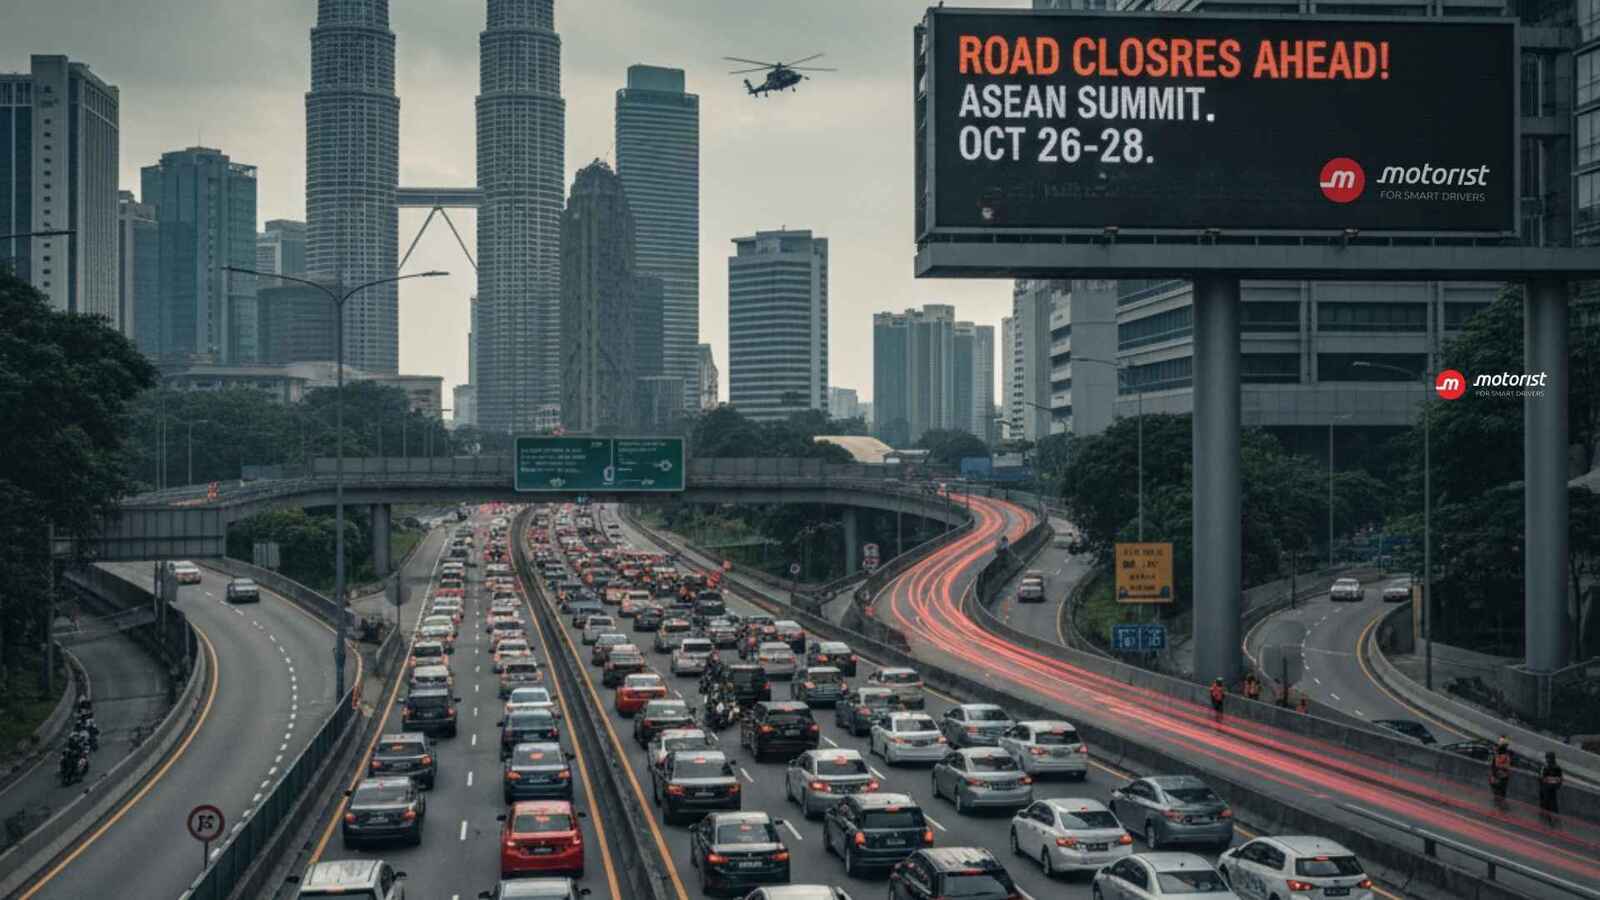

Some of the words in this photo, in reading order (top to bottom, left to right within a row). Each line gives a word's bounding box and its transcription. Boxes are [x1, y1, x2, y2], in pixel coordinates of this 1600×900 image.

[958, 34, 1060, 77] ROAD
[1072, 38, 1242, 79] CLOSRES
[1253, 40, 1390, 80] AHEAD!
[959, 83, 1067, 119] ASEAN
[1077, 85, 1216, 122] SUMMIT.
[959, 126, 1026, 162] OCT
[1037, 127, 1155, 164] 26-28.
[1376, 163, 1490, 186] motorist
[1380, 190, 1401, 201] FOR
[1404, 190, 1438, 201] SMART
[1441, 191, 1486, 202] DRIVERS
